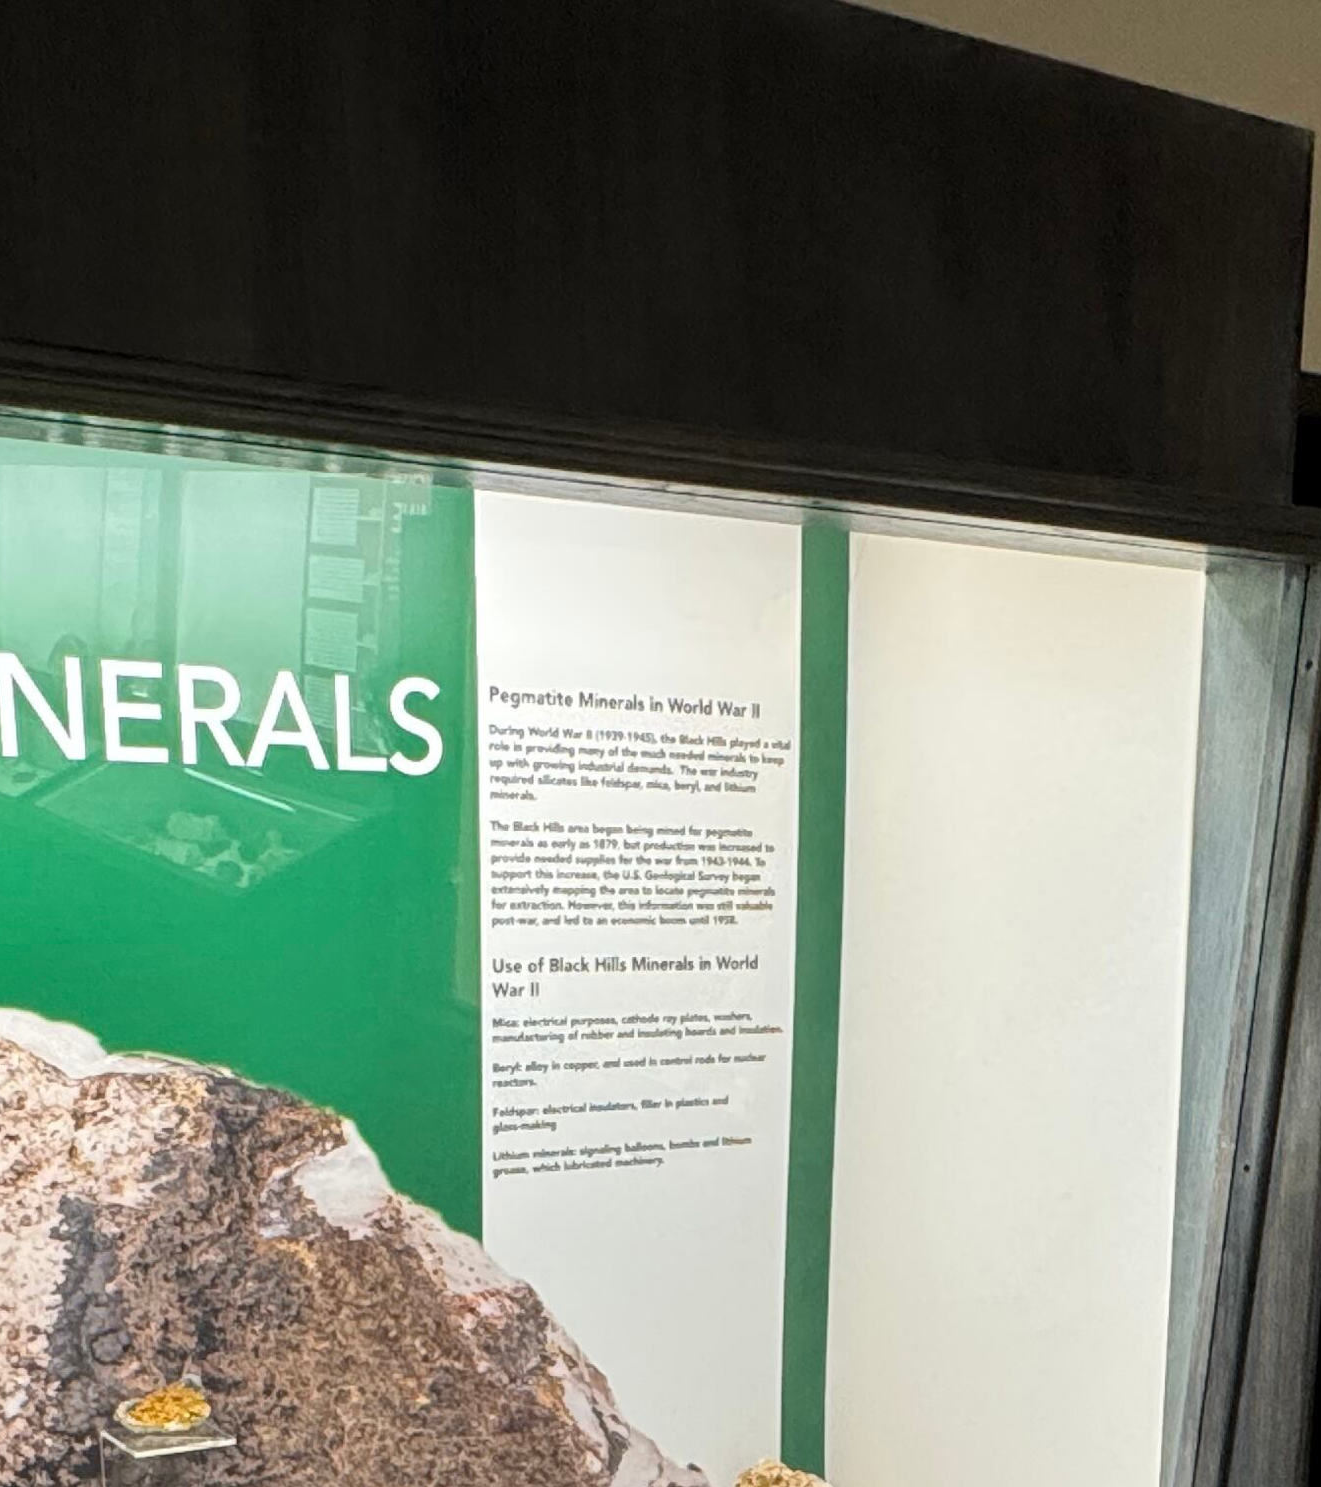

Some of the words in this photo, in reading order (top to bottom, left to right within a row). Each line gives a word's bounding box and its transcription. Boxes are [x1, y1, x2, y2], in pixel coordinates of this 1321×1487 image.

[489, 687, 573, 708] Pegmatite
[578, 693, 644, 711] Minerals
[649, 696, 663, 712] in
[667, 698, 712, 715] World
[717, 701, 746, 717] War
[751, 703, 760, 718] II
[488, 724, 524, 739] During
[528, 727, 559, 738] World
[562, 729, 582, 738] War
[585, 730, 592, 739] II
[659, 734, 676, 744] the
[678, 735, 704, 745] Black
[706, 736, 726, 746] Hills
[729, 738, 761, 750] played
[770, 740, 791, 750] vital
[488, 741, 510, 751] role
[525, 744, 575, 757] providing
[578, 748, 605, 758] many
[607, 746, 618, 756] of
[621, 747, 638, 757] the
[640, 749, 666, 758] much
[668, 751, 705, 761] needed
[707, 753, 746, 763] minerals
[748, 754, 760, 763] to
[761, 754, 784, 767] keep
[489, 760, 503, 770] up
[506, 758, 529, 768] with
[532, 762, 575, 773] growing
[578, 761, 624, 772] industrial
[679, 765, 697, 775] The
[719, 768, 758, 781] industry
[489, 775, 534, 785] required
[537, 775, 577, 786] silicates
[580, 776, 598, 787] like
[703, 782, 721, 792] and
[723, 782, 756, 792] lithium
[489, 791, 536, 800] minerals.
[491, 821, 509, 831] The
[512, 821, 539, 831] Black
[542, 822, 564, 832] Hills
[567, 825, 589, 833] area
[592, 824, 623, 837] began
[625, 825, 654, 838] being
[688, 825, 702, 836] for
[705, 829, 753, 839] pegmatite
[550, 839, 576, 851] early
[622, 839, 640, 849] but
[642, 842, 695, 851] production
[718, 843, 762, 852] increased
[490, 853, 531, 864] provide
[533, 854, 572, 864] needed
[575, 855, 615, 866] supplies
[618, 854, 632, 864] for
[635, 855, 651, 865] the
[674, 855, 698, 866] from
[754, 857, 766, 867] To
[490, 870, 531, 880] support
[534, 868, 553, 879] this
[602, 870, 620, 880] the
[621, 870, 641, 880] U.S.
[644, 870, 695, 882] Geological
[697, 871, 729, 883] Survey
[731, 872, 761, 884] began
[490, 885, 549, 895] extensively
[552, 887, 596, 898] mapping
[598, 885, 615, 895] the
[641, 887, 652, 895] to
[654, 886, 684, 895] locate
[737, 887, 776, 896] minerals
[490, 899, 506, 909] for
[617, 900, 635, 910] this
[638, 900, 693, 910] information
[541, 915, 561, 925] and
[563, 915, 579, 925] led
[582, 917, 593, 925] to
[688, 915, 709, 925] until
[492, 959, 522, 973] Use
[527, 957, 544, 973] of
[549, 957, 589, 972] Black
[594, 957, 626, 972] Hills
[631, 957, 694, 971] Minerals
[698, 957, 711, 970] in
[715, 955, 758, 970] World
[492, 982, 524, 997] War
[530, 981, 539, 996] II
[522, 1017, 567, 1027] electrical
[621, 1014, 659, 1024] cathode
[662, 1016, 677, 1025] ray
[491, 1032, 565, 1043] manufacturing
[567, 1030, 578, 1040] of
[580, 1030, 614, 1039] rubber
[616, 1029, 634, 1038] and
[637, 1029, 683, 1039] insulating
[684, 1027, 716, 1036] boards
[718, 1026, 736, 1035] and
[525, 1061, 548, 1073] alloy
[551, 1061, 560, 1070] in
[602, 1058, 620, 1068] and
[623, 1057, 646, 1067] used
[648, 1057, 657, 1066] in
[659, 1057, 693, 1065] control
[694, 1055, 715, 1064] rods
[717, 1054, 731, 1063] for
[542, 1104, 587, 1114] electrical
[640, 1100, 661, 1109] filler
[664, 1099, 673, 1108] in
[675, 1098, 709, 1109] plastics
[711, 1096, 729, 1105] and
[492, 1152, 529, 1161] Lithium
[702, 1137, 719, 1147] and
[532, 1162, 560, 1172] which
[563, 1159, 612, 1170] lubricated
